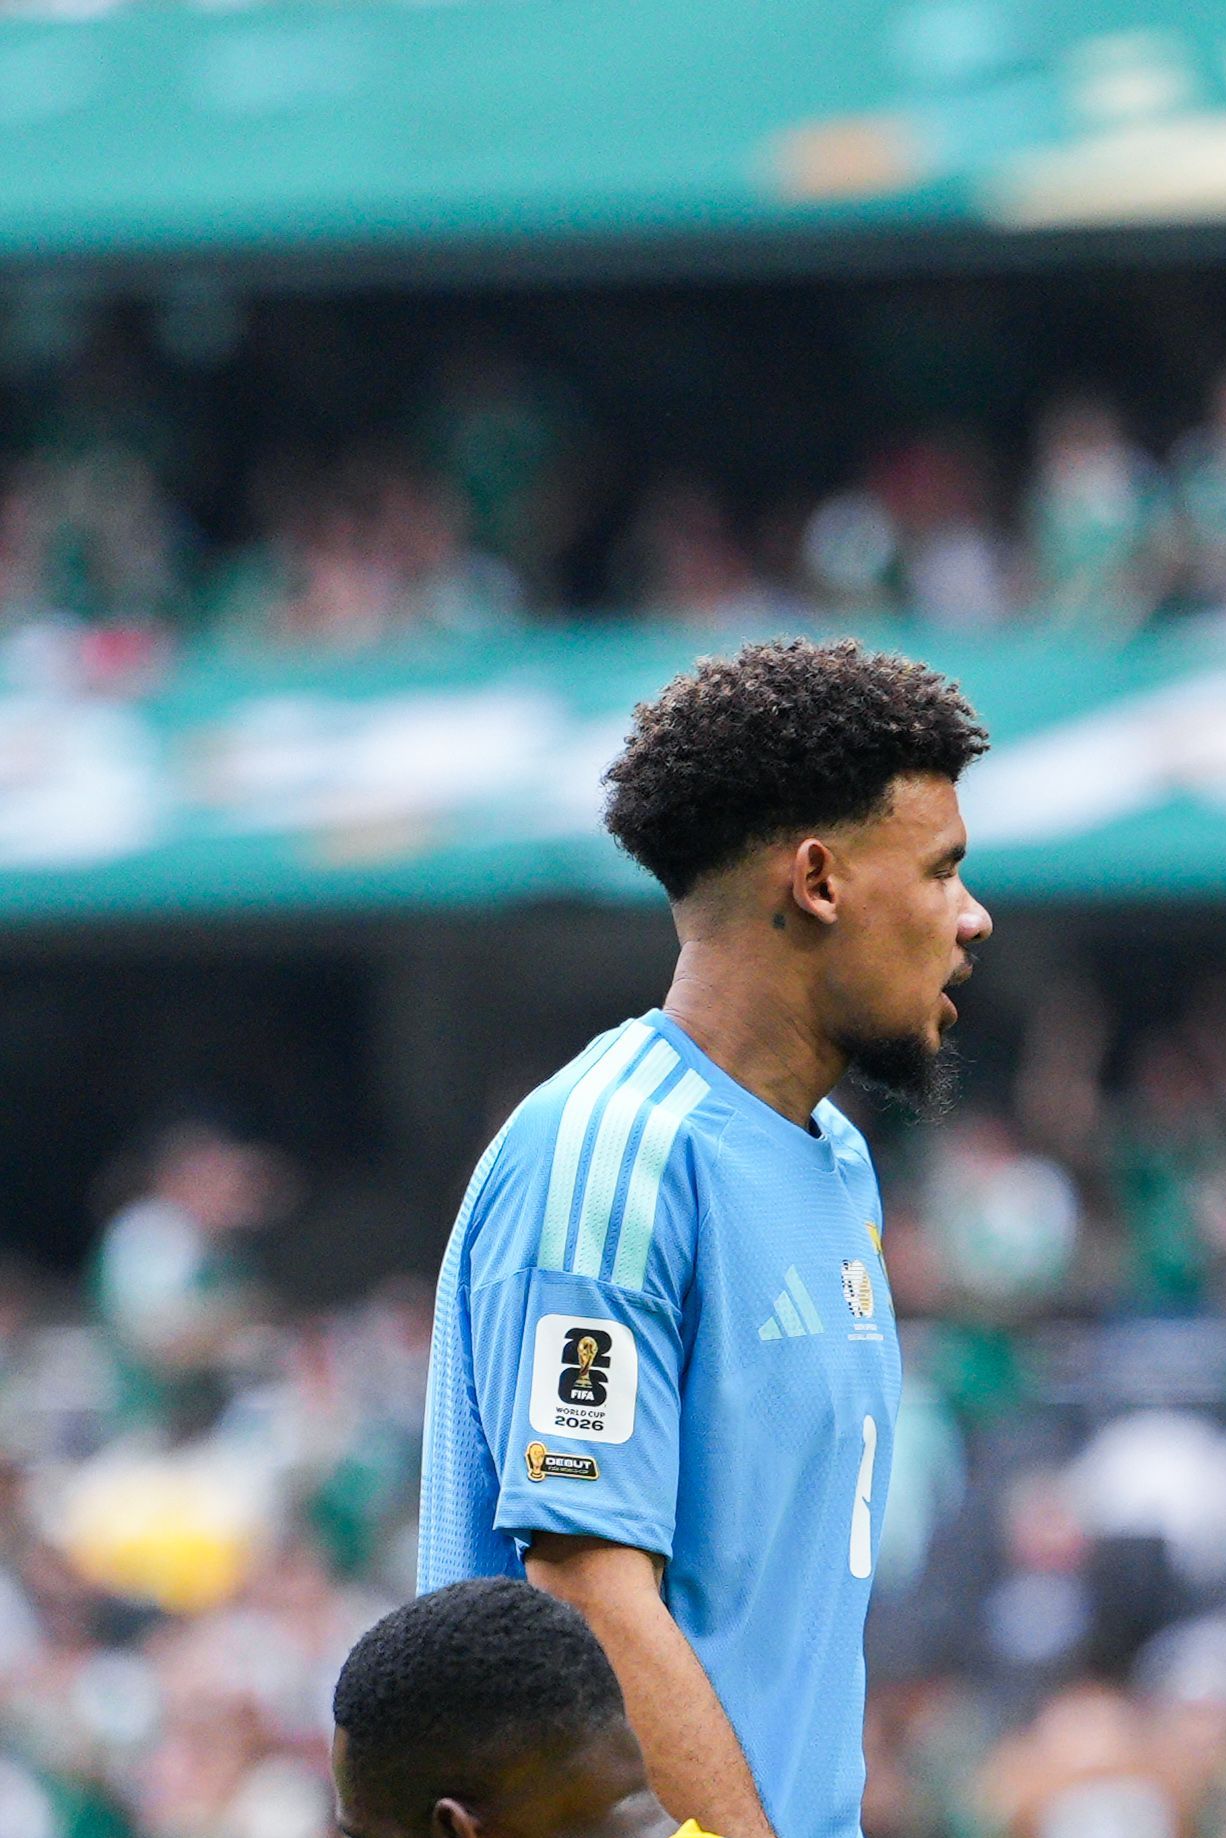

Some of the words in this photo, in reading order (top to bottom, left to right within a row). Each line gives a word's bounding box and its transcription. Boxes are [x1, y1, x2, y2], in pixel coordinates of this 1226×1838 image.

[570, 1388, 595, 1401] FIFA
[556, 1406, 587, 1417] WORLD
[588, 1410, 606, 1419] CUP
[555, 1415, 604, 1431] 2026
[545, 1456, 592, 1470] DEBUT
